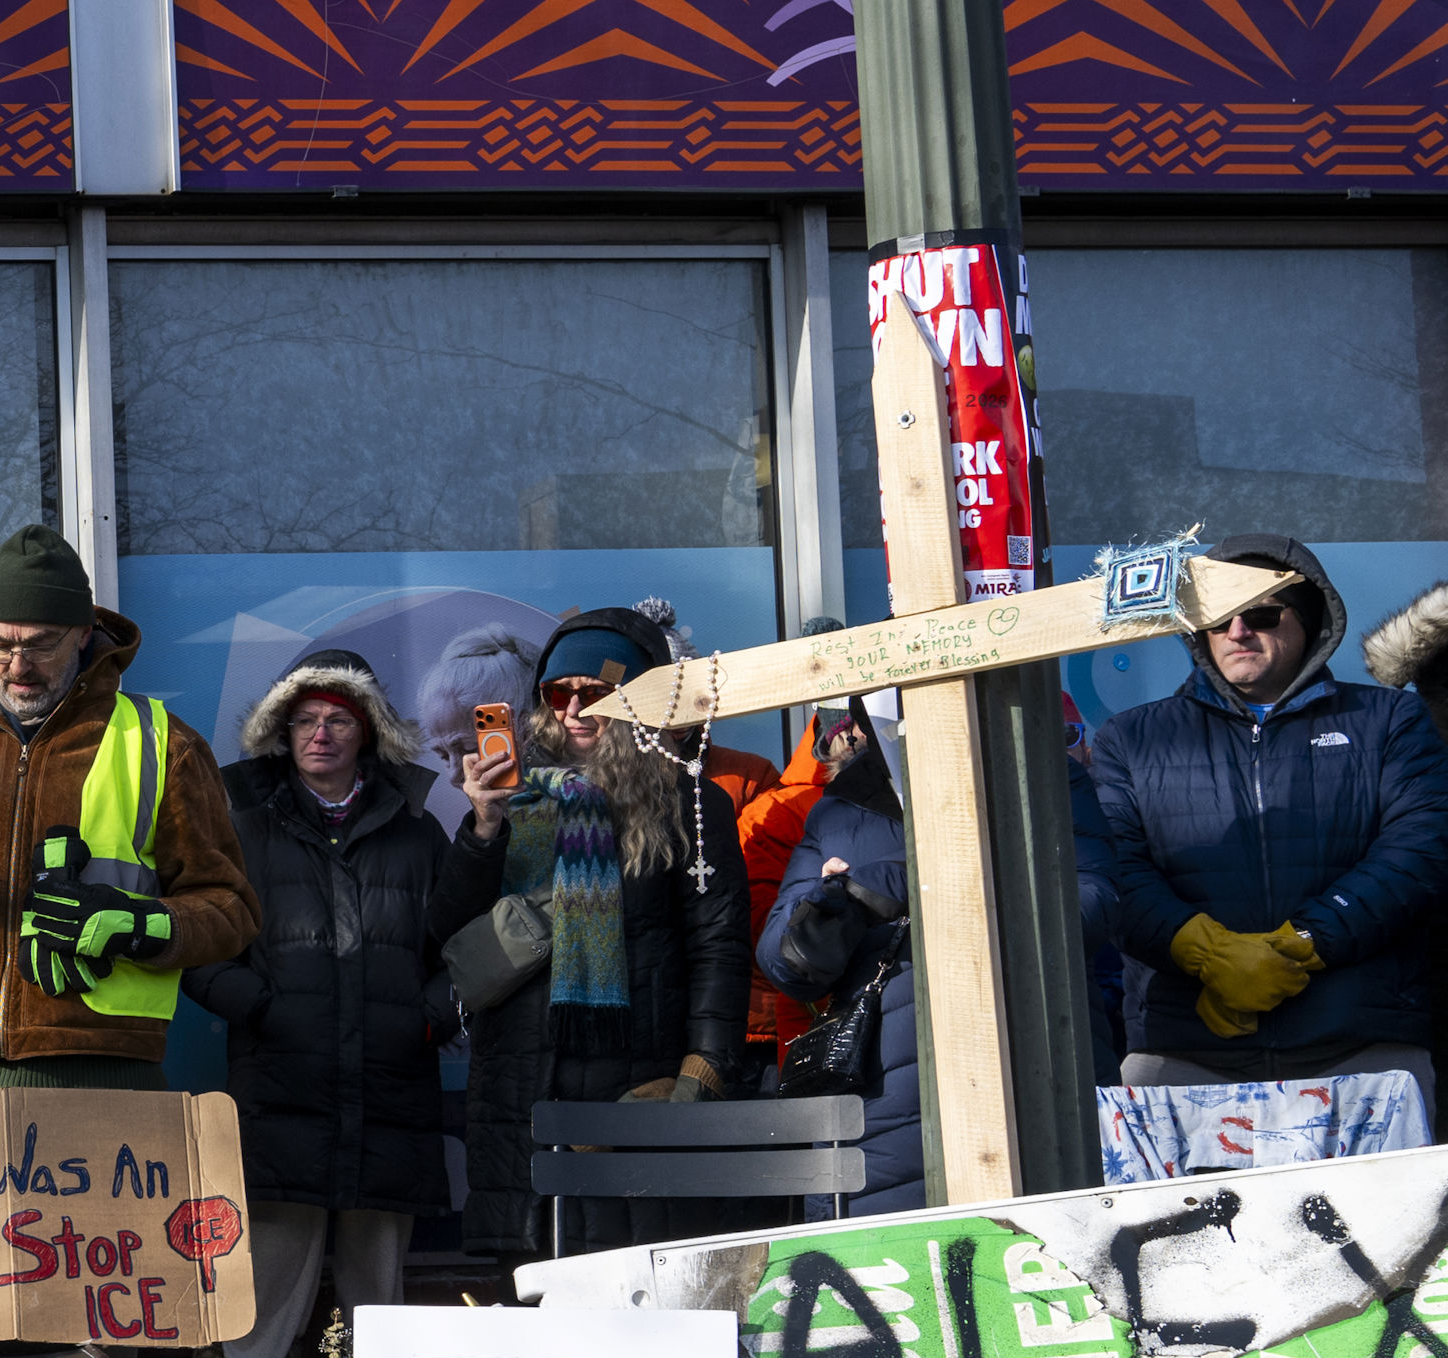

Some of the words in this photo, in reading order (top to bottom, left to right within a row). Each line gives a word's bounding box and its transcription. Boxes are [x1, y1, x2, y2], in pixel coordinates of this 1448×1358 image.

[868, 247, 980, 326] SHUT
[965, 394, 1008, 409] 2026
[810, 635, 857, 659] Rest
[925, 618, 977, 639] Peace
[819, 674, 844, 692] will
[860, 670, 875, 683] be
[112, 1143, 169, 1199] An
[183, 1217, 225, 1244] ICE
[85, 1278, 179, 1340] ICE
